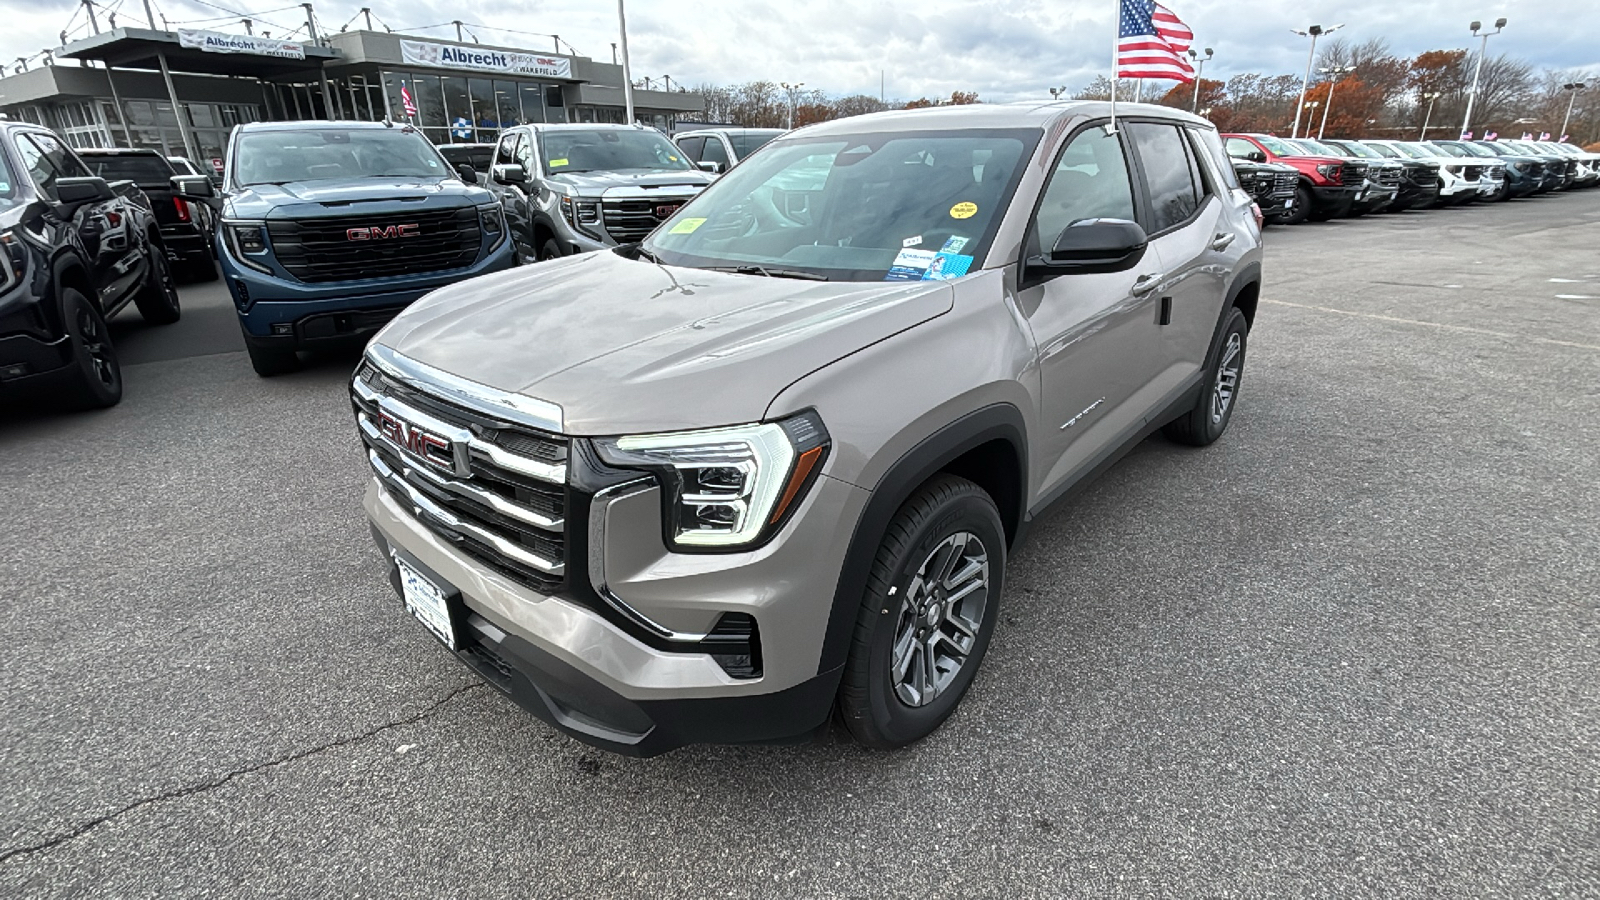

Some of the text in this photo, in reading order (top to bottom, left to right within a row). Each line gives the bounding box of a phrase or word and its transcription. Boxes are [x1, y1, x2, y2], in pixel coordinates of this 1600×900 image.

[206, 36, 256, 51] Albrecht
[442, 47, 507, 68] Albrecht
[536, 58, 557, 66] GMC
[519, 67, 558, 76] WAKEFIELD
[346, 223, 421, 241] GMC
[378, 410, 454, 470] GMC
